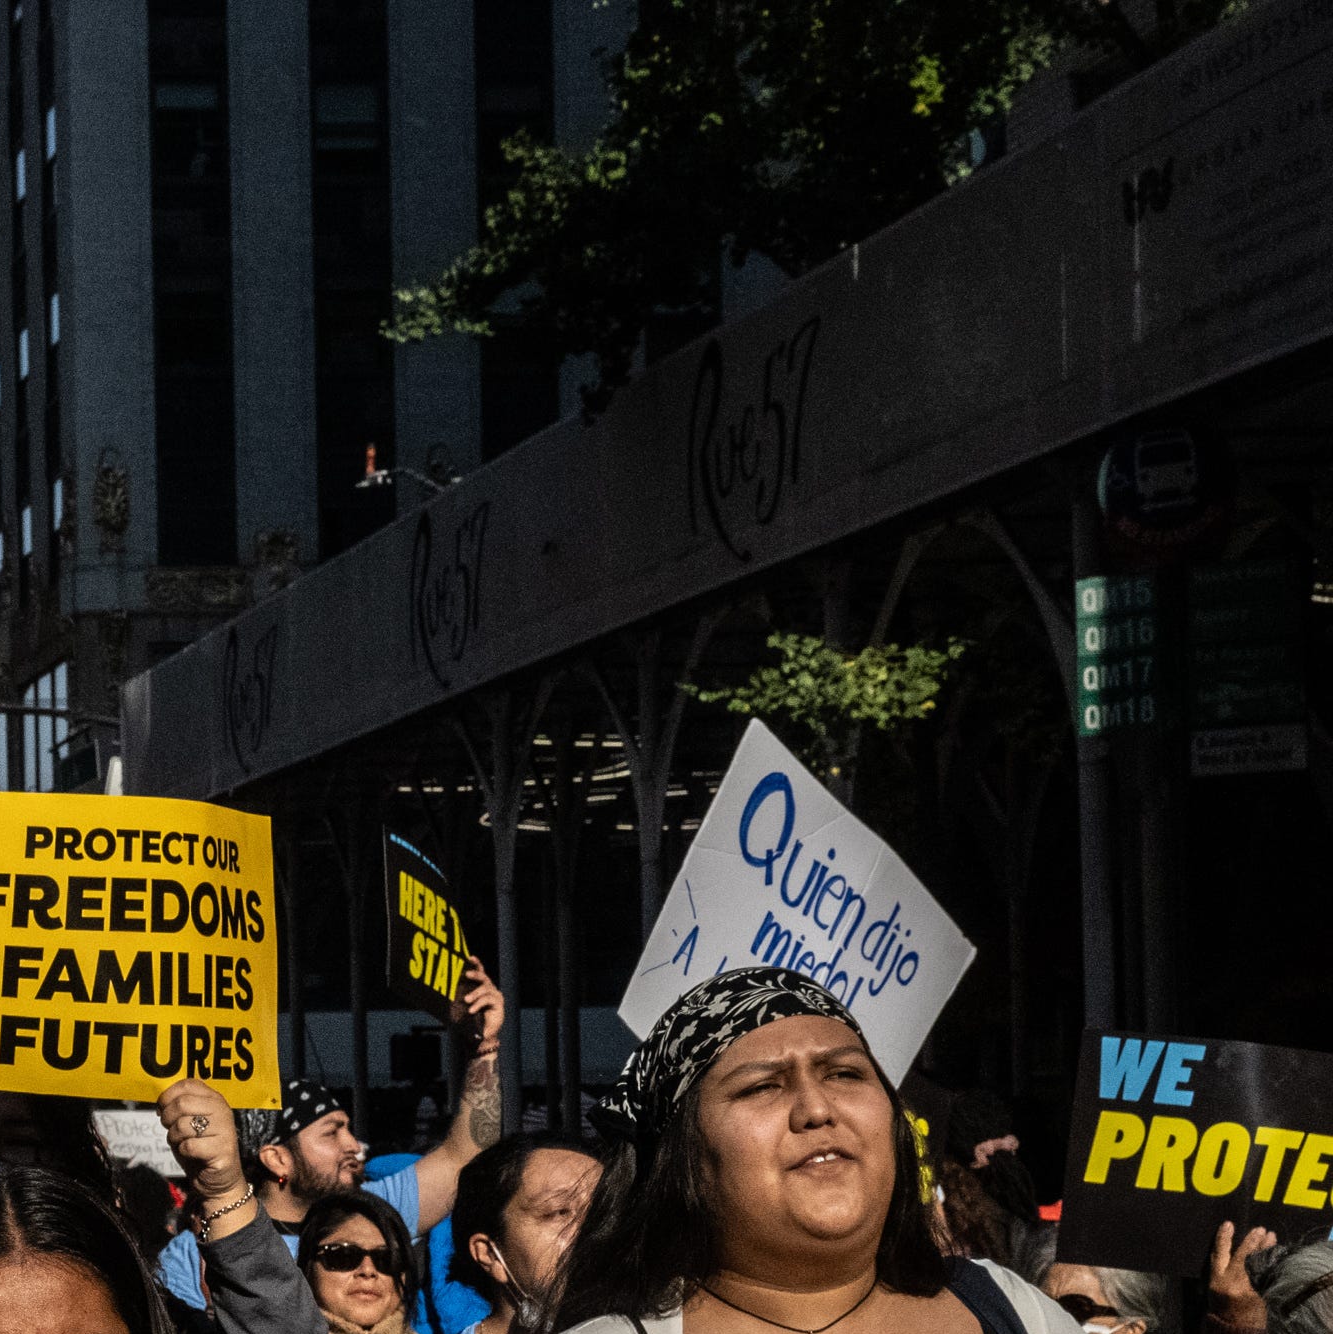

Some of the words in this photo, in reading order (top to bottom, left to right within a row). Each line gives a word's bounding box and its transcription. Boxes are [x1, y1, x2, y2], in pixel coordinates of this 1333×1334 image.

[25, 826, 200, 867] PROTECT
[202, 832, 240, 874] OUR
[738, 771, 867, 951] Quien
[861, 901, 919, 997] dijo
[399, 870, 447, 944] HERE
[1, 945, 253, 1012] FAMILIES
[409, 930, 464, 1002] STAY
[1099, 1036, 1206, 1107] WE
[1083, 1110, 1333, 1209] PROTE
